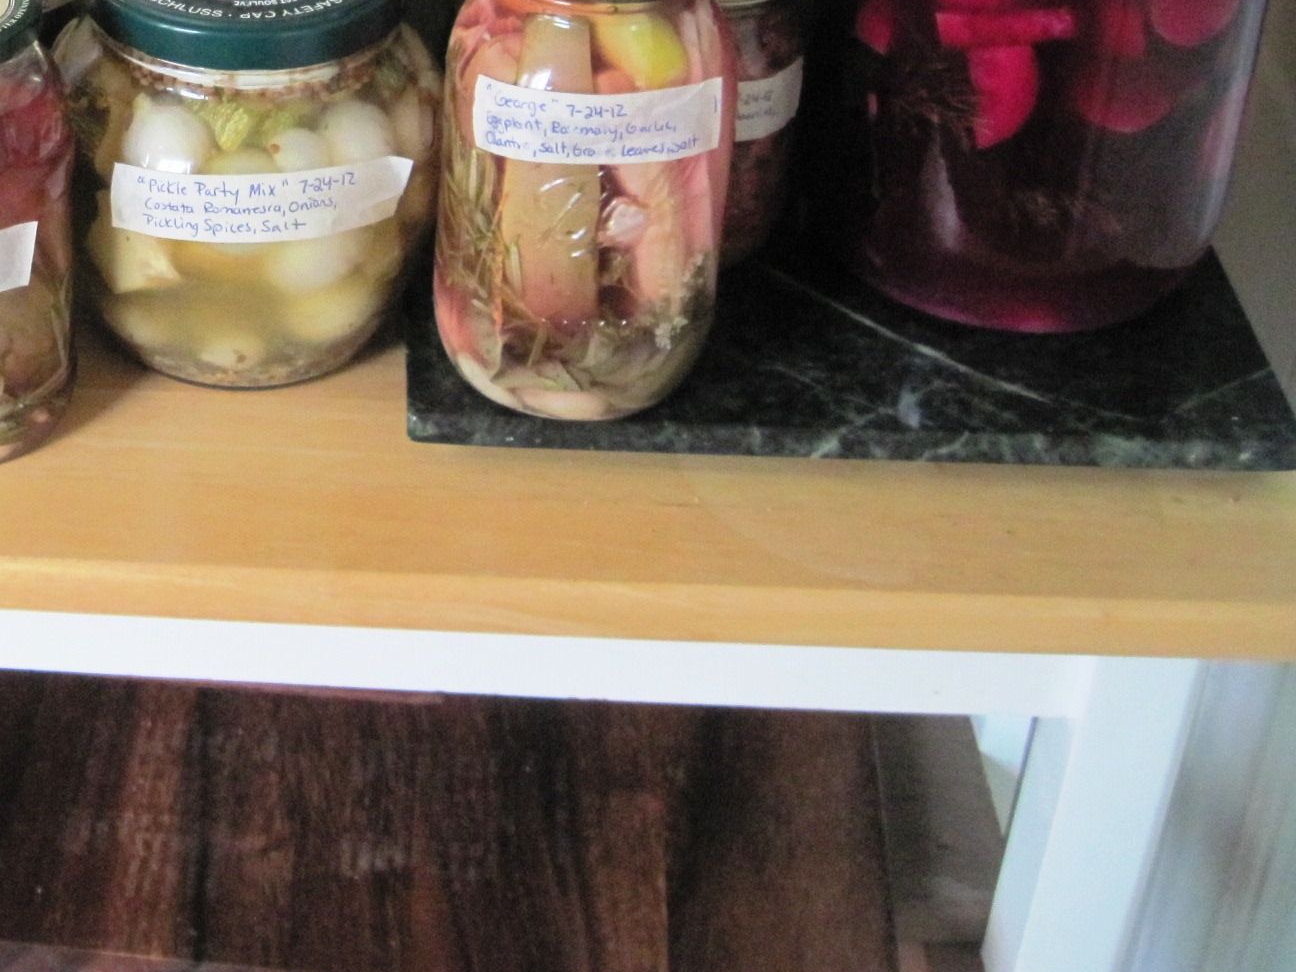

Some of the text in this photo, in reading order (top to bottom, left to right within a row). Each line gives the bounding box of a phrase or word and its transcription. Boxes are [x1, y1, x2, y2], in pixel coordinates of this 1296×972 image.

[240, 9, 277, 20] CAP
[566, 104, 628, 118] 7-24-12
[194, 180, 240, 205] Party
[299, 172, 357, 195] 7-24-12
[143, 212, 199, 237] Pickling
[261, 218, 307, 233] Salt
